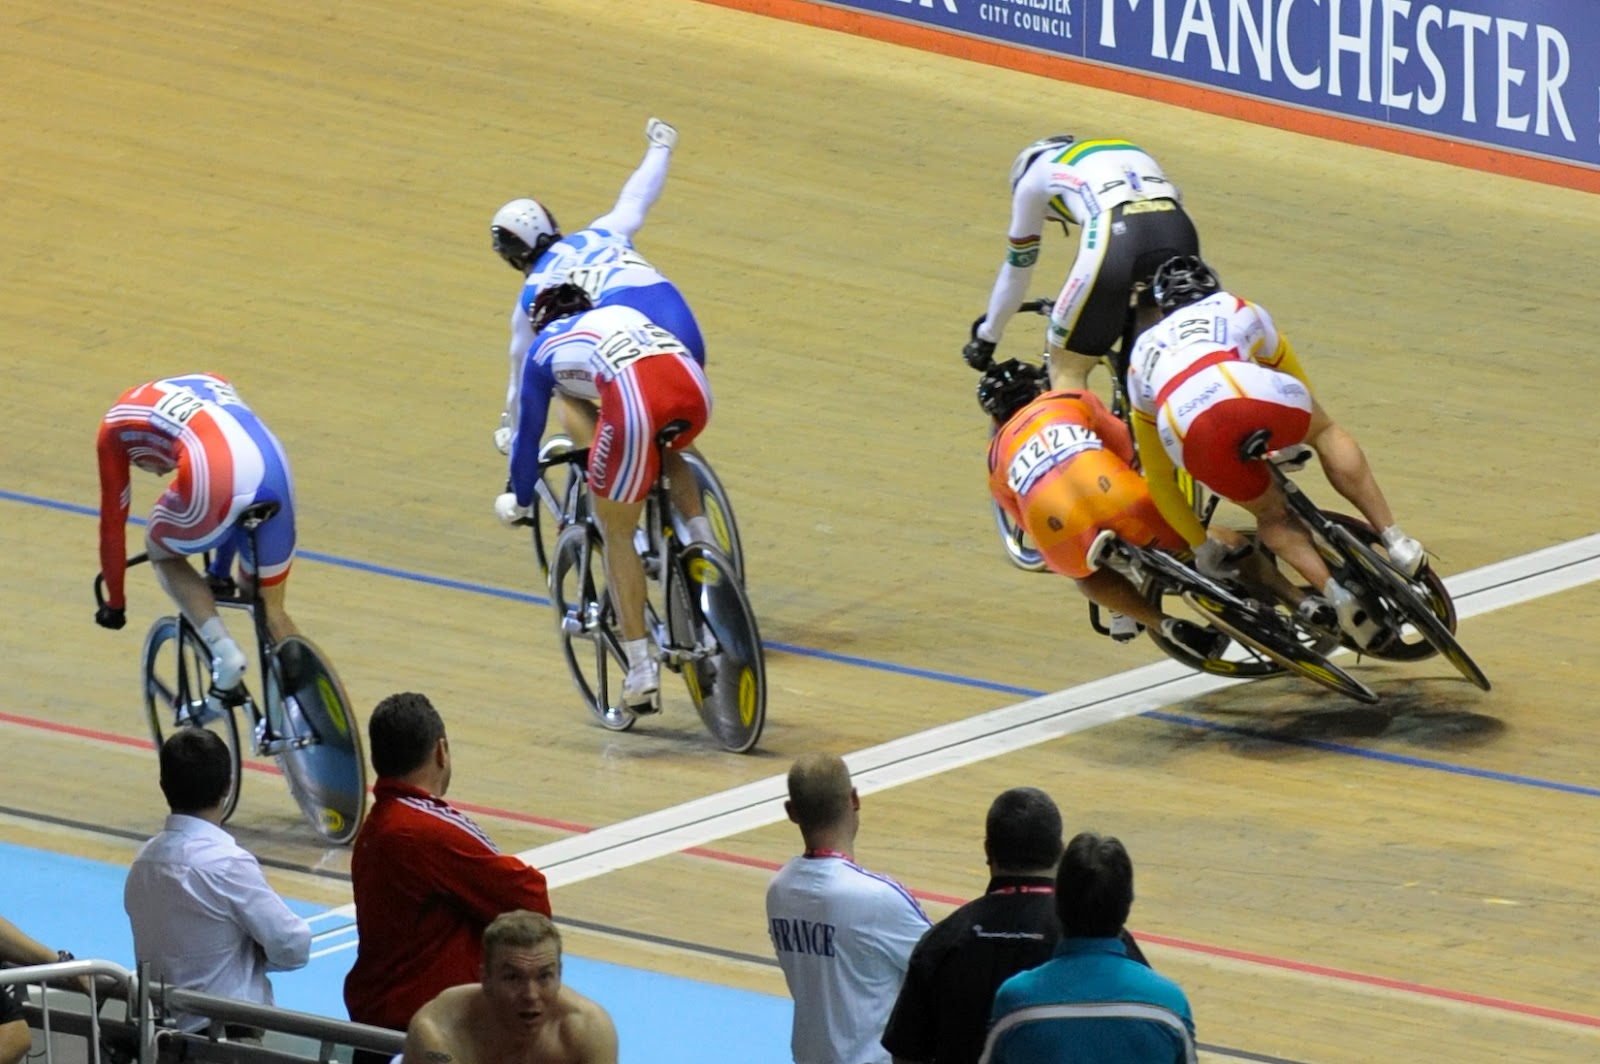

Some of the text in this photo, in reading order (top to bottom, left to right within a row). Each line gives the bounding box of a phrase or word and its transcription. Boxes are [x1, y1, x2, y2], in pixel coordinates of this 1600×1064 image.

[979, 3, 1009, 24] CITY
[1014, 11, 1072, 38] COUNCIL
[1178, 317, 1211, 340] 89
[599, 330, 642, 370] 102
[160, 390, 204, 423] 123
[592, 423, 614, 490] COFIDIS
[1010, 440, 1046, 486] 212
[771, 917, 836, 959] FRANCE
